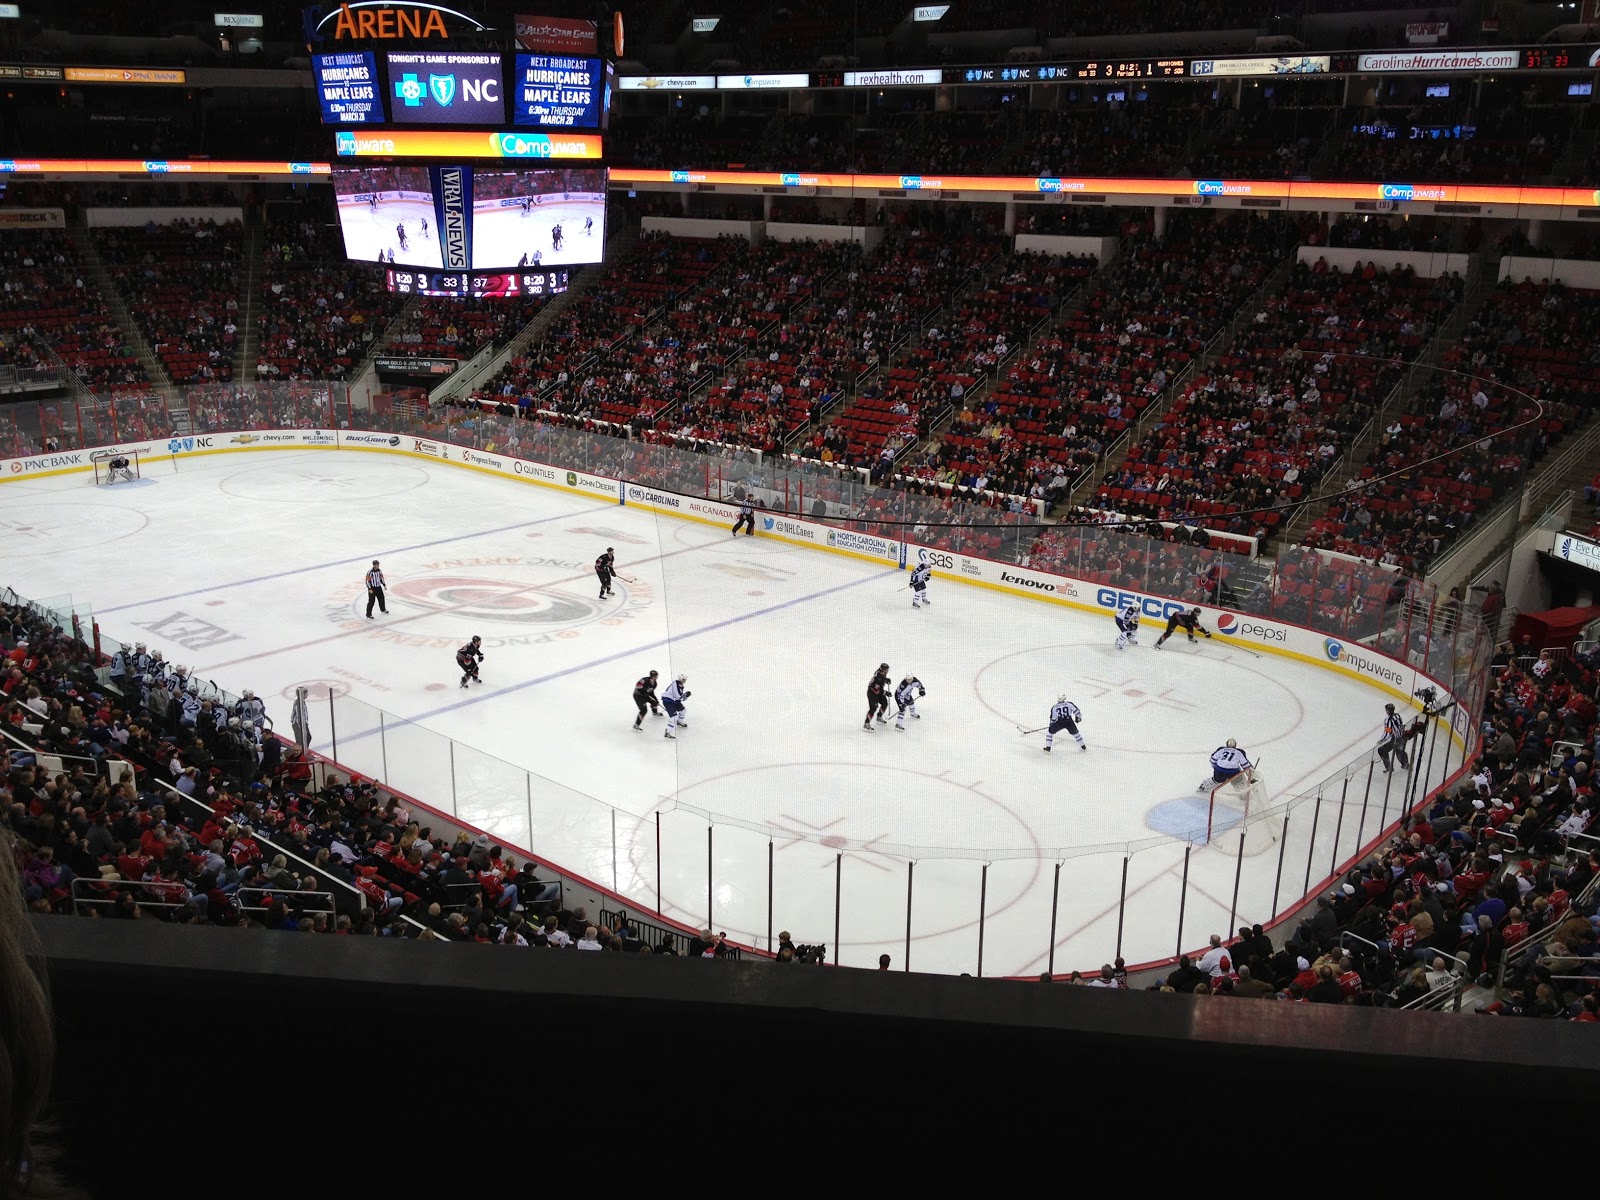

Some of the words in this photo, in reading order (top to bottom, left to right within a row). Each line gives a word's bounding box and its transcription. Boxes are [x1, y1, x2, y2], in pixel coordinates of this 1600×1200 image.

[918, 9, 929, 17] REX
[224, 16, 236, 24] REX
[335, 2, 448, 40] ARENA
[694, 21, 704, 29] REX
[525, 26, 540, 35] ALL
[550, 28, 573, 37] STAR
[573, 29, 596, 39] GAME
[322, 56, 334, 66] NEXT
[336, 54, 364, 65] BROADCAST
[388, 54, 425, 64] TONIGHT'S
[426, 55, 446, 64] GAME
[448, 55, 488, 64] SPONSORED
[488, 56, 500, 64] BY
[531, 57, 548, 67] NEXT
[550, 58, 587, 70] BROADCAST
[1363, 51, 1512, 70] CarolinaHurricanes.com
[1527, 56, 1540, 67] 37
[1555, 56, 1568, 66] 33
[322, 66, 369, 81] HURRICANES
[983, 69, 994, 79] NC
[1019, 68, 1030, 79] NC
[1056, 67, 1068, 77] NC
[1106, 65, 1113, 76] 3
[1147, 64, 1152, 75] 1
[1192, 61, 1214, 75] CEI
[526, 70, 590, 85] HURRICANES
[860, 72, 924, 85] rexhealth.com
[324, 87, 350, 100] MAPLE
[350, 87, 374, 99] LEAFS
[462, 80, 499, 102] NC
[524, 89, 559, 103] MAPLE
[561, 91, 591, 104] LEAFS
[346, 103, 371, 112] THURSDAY
[528, 106, 549, 115] 6:30PM
[551, 106, 585, 116] THURSDAY
[340, 112, 358, 121] MARCH
[359, 113, 365, 121] 28
[540, 115, 566, 124] MARCH
[502, 135, 587, 157] Compuware
[0, 162, 40, 171] ompuware
[146, 162, 192, 172] Compuware
[672, 171, 706, 182] Compuware
[782, 174, 818, 185] Compuware
[902, 176, 941, 188] Compuware
[1039, 179, 1084, 191] Compuware
[1198, 182, 1250, 195] Compuware
[442, 170, 462, 214] WRAL
[1384, 185, 1445, 199] Compuware
[446, 216, 464, 266] NEWS
[389, 272, 394, 285] 1
[396, 274, 412, 284] 8:20
[418, 274, 427, 289] 3
[444, 278, 458, 287] 33
[474, 278, 487, 287] 37
[508, 275, 518, 290] 1
[524, 275, 544, 285] 8:20
[550, 273, 557, 287] 3
[197, 437, 213, 448] NC
[24, 459, 49, 470] PNC
[51, 454, 82, 466] BANK
[471, 454, 488, 465] Progress
[488, 458, 502, 468] Energy
[524, 465, 555, 479] QUINTILES
[578, 477, 595, 488] JOHN
[595, 480, 616, 492] DEERE
[632, 489, 642, 497] FOX
[645, 492, 679, 507] CAROLINAS
[689, 503, 701, 511] AIR
[703, 505, 733, 519] CANADA
[776, 521, 814, 539] @NHLCanes
[837, 532, 858, 543] NORTH
[859, 535, 886, 548] CAROLINA
[837, 539, 864, 551] EDUCATION
[865, 544, 886, 554] LOTTERY
[1576, 540, 1590, 554] Eye
[929, 552, 953, 569] sas
[1001, 572, 1055, 591] lenovo
[1097, 588, 1184, 619] GEICO
[131, 611, 246, 650] REX
[1241, 622, 1287, 642] pepsi
[1327, 642, 1403, 685] Compuware
[1056, 707, 1068, 716] 39
[1222, 752, 1235, 761] 31
